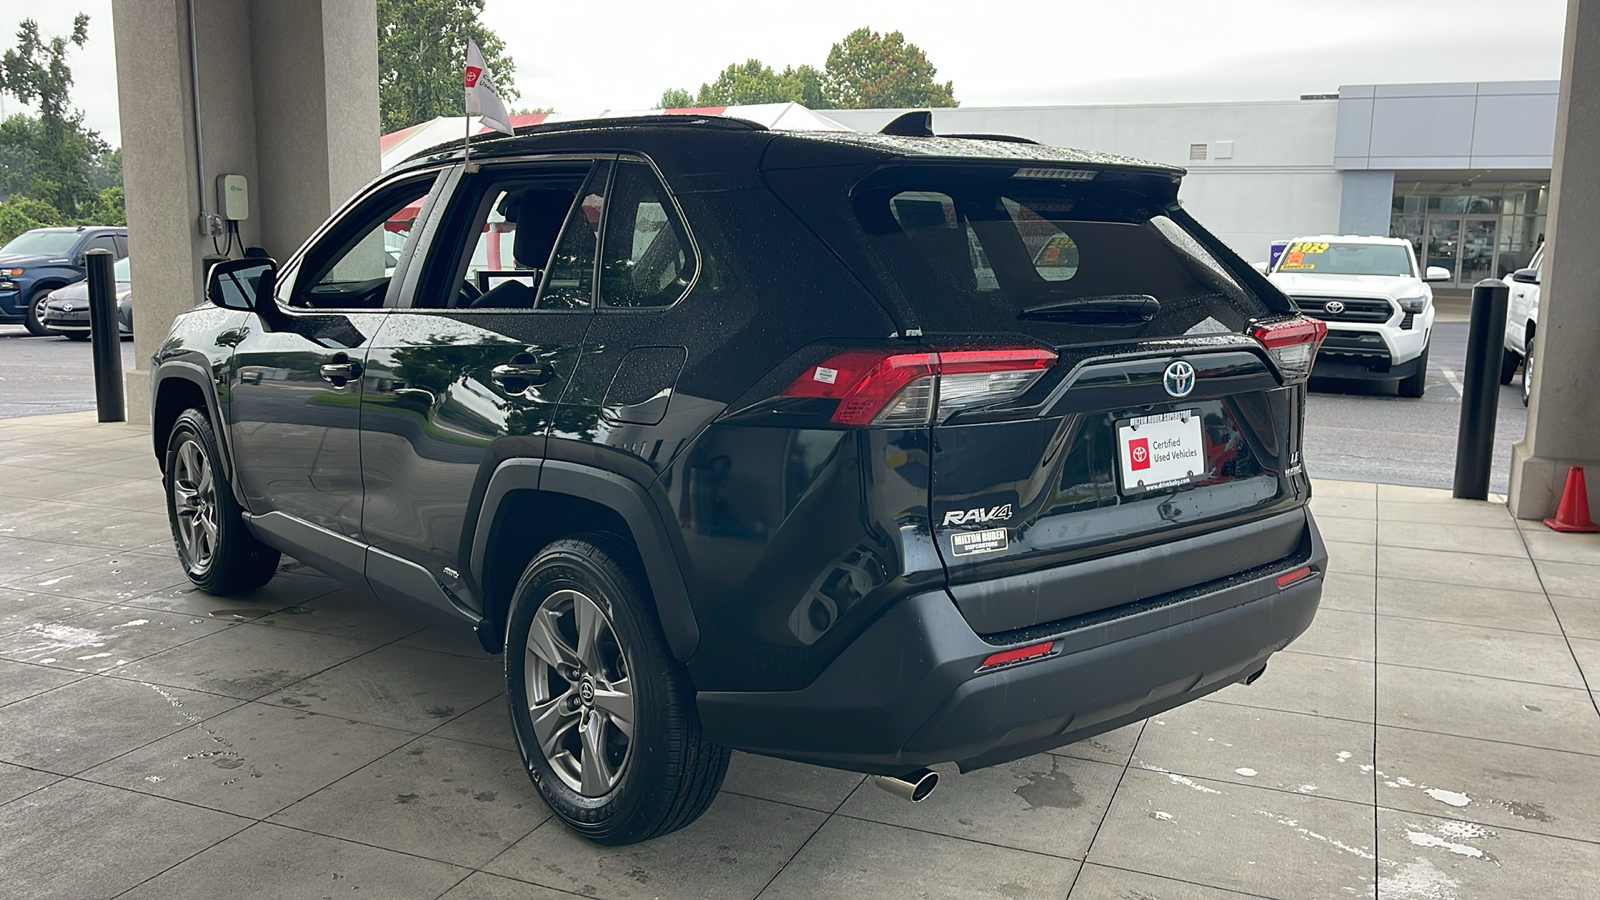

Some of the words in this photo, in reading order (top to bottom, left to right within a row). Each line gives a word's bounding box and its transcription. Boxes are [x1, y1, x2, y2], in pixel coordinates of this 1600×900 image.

[1163, 409, 1192, 422] SUPERSTORE
[1152, 437, 1181, 450] Certified
[1153, 452, 1171, 463] Used
[1171, 448, 1198, 460] Vehicles
[1145, 477, 1191, 491] www.drivebaby.com
[942, 503, 1013, 526] RAV4
[954, 533, 981, 546] MILTON
[981, 529, 1005, 542] RUBEN
[964, 541, 998, 551] SUPERSTORE
